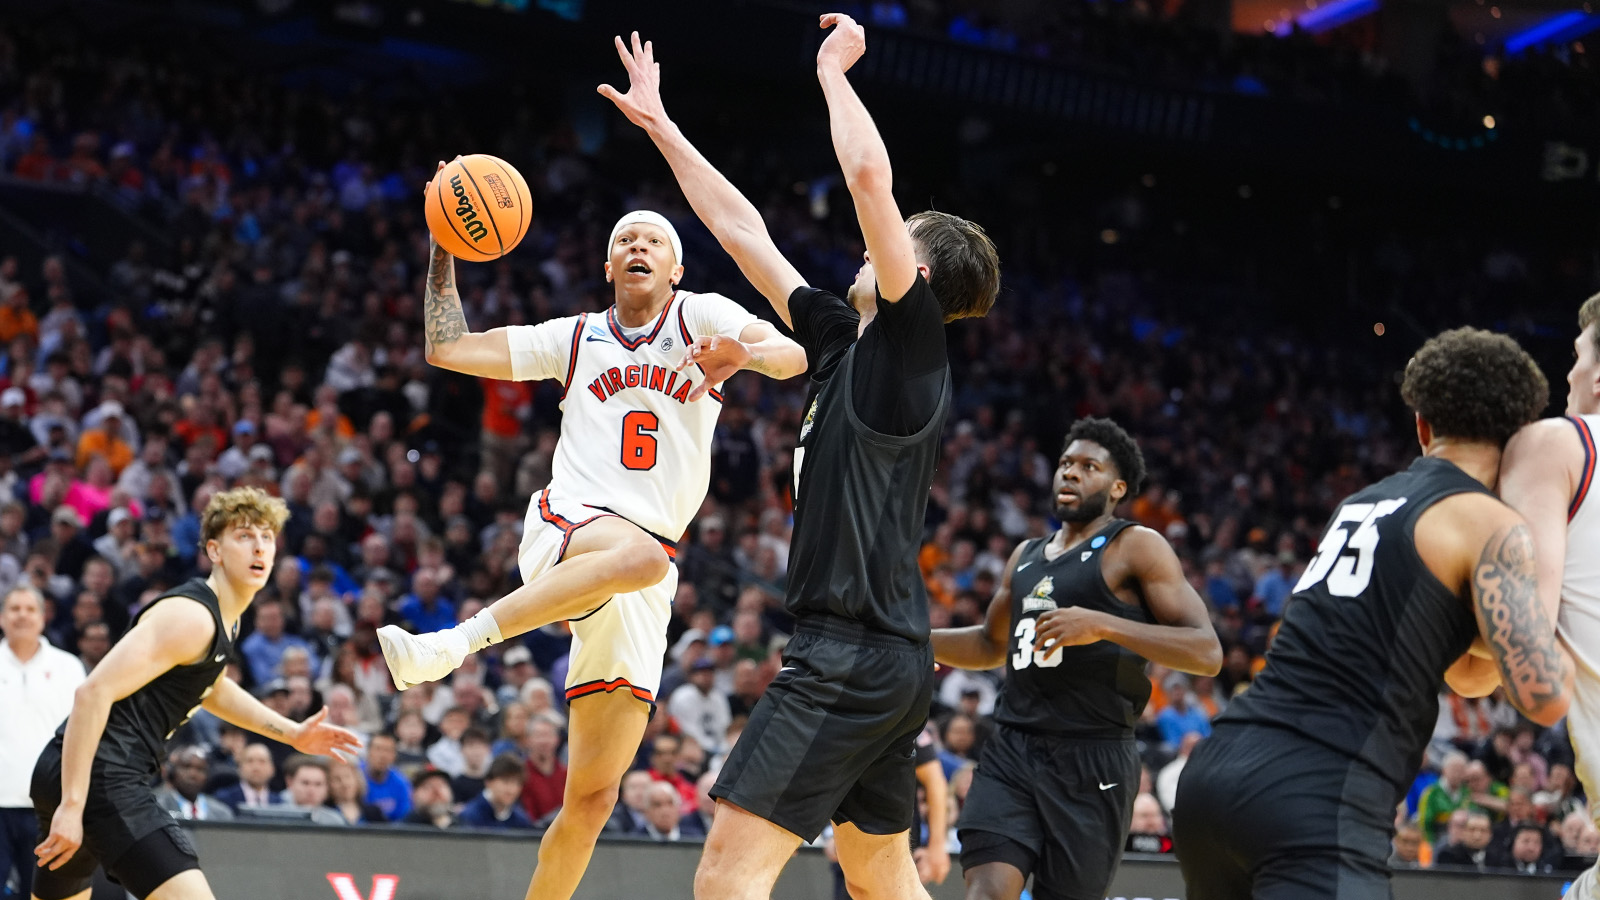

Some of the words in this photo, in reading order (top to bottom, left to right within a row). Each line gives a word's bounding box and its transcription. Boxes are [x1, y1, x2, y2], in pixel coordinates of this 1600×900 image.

[449, 173, 488, 243] Wilson
[588, 364, 692, 404] VIRGINIA
[620, 410, 659, 471] 6
[1292, 497, 1408, 598] 55
